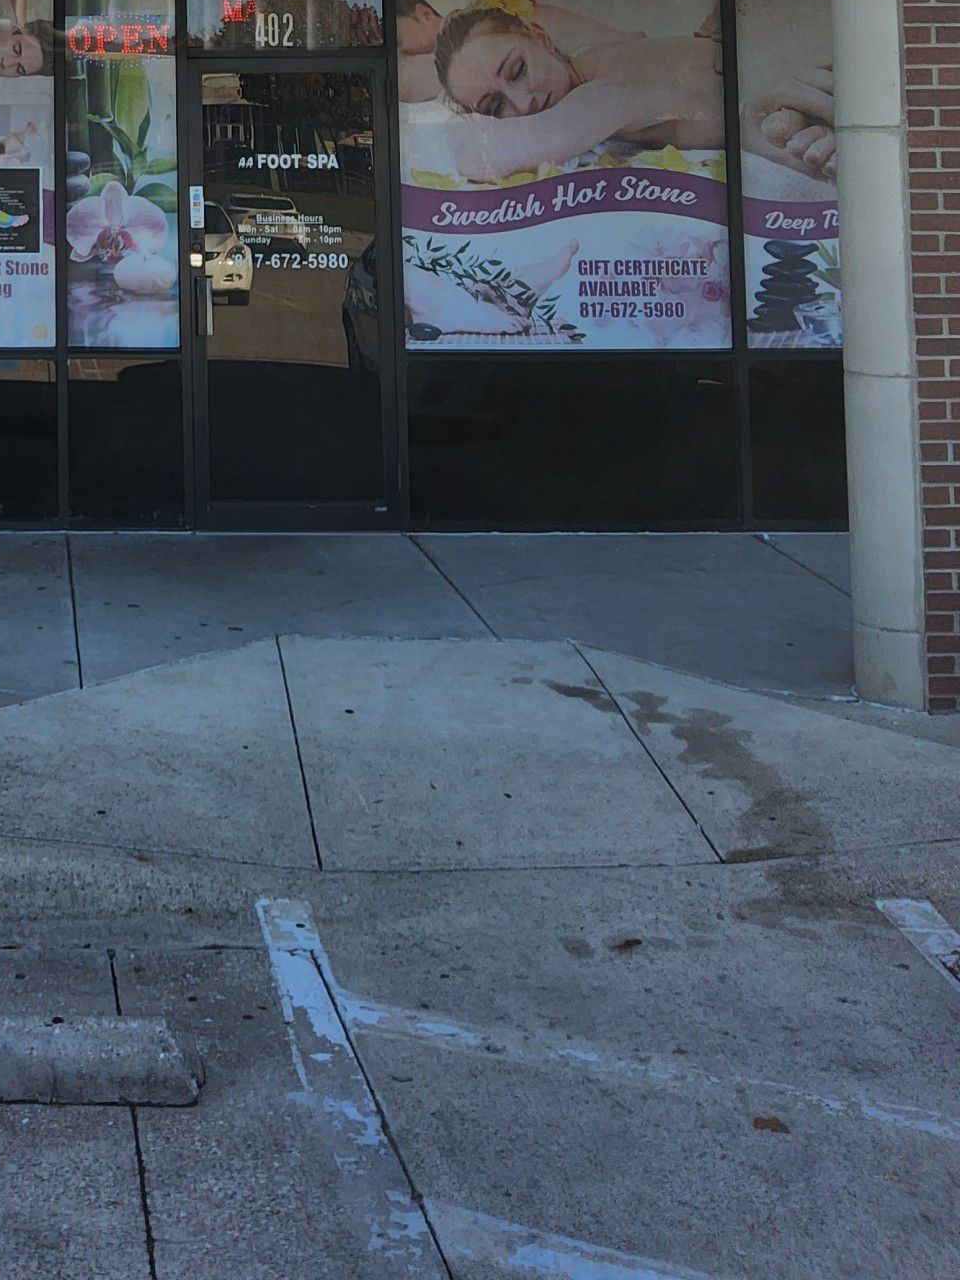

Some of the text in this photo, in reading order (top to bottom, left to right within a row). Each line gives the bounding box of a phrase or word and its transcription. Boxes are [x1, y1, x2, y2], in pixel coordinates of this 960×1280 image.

[255, 13, 294, 47] 402
[66, 23, 170, 56] OPEN
[238, 153, 339, 169] AA FOOT SPA
[432, 176, 698, 226] Swedish Hot Stone
[256, 213, 323, 223] Business Hours
[765, 211, 817, 236] Deep
[264, 224, 279, 233] Sat
[320, 224, 342, 236] 10pm
[239, 235, 271, 246] Sunday
[320, 235, 342, 246] 10pm
[5, 260, 49, 276] Stone
[578, 260, 708, 276] GIFT CERTIFICATE
[579, 281, 657, 297] AVAILABLE
[580, 302, 685, 318] 817-672-5980
